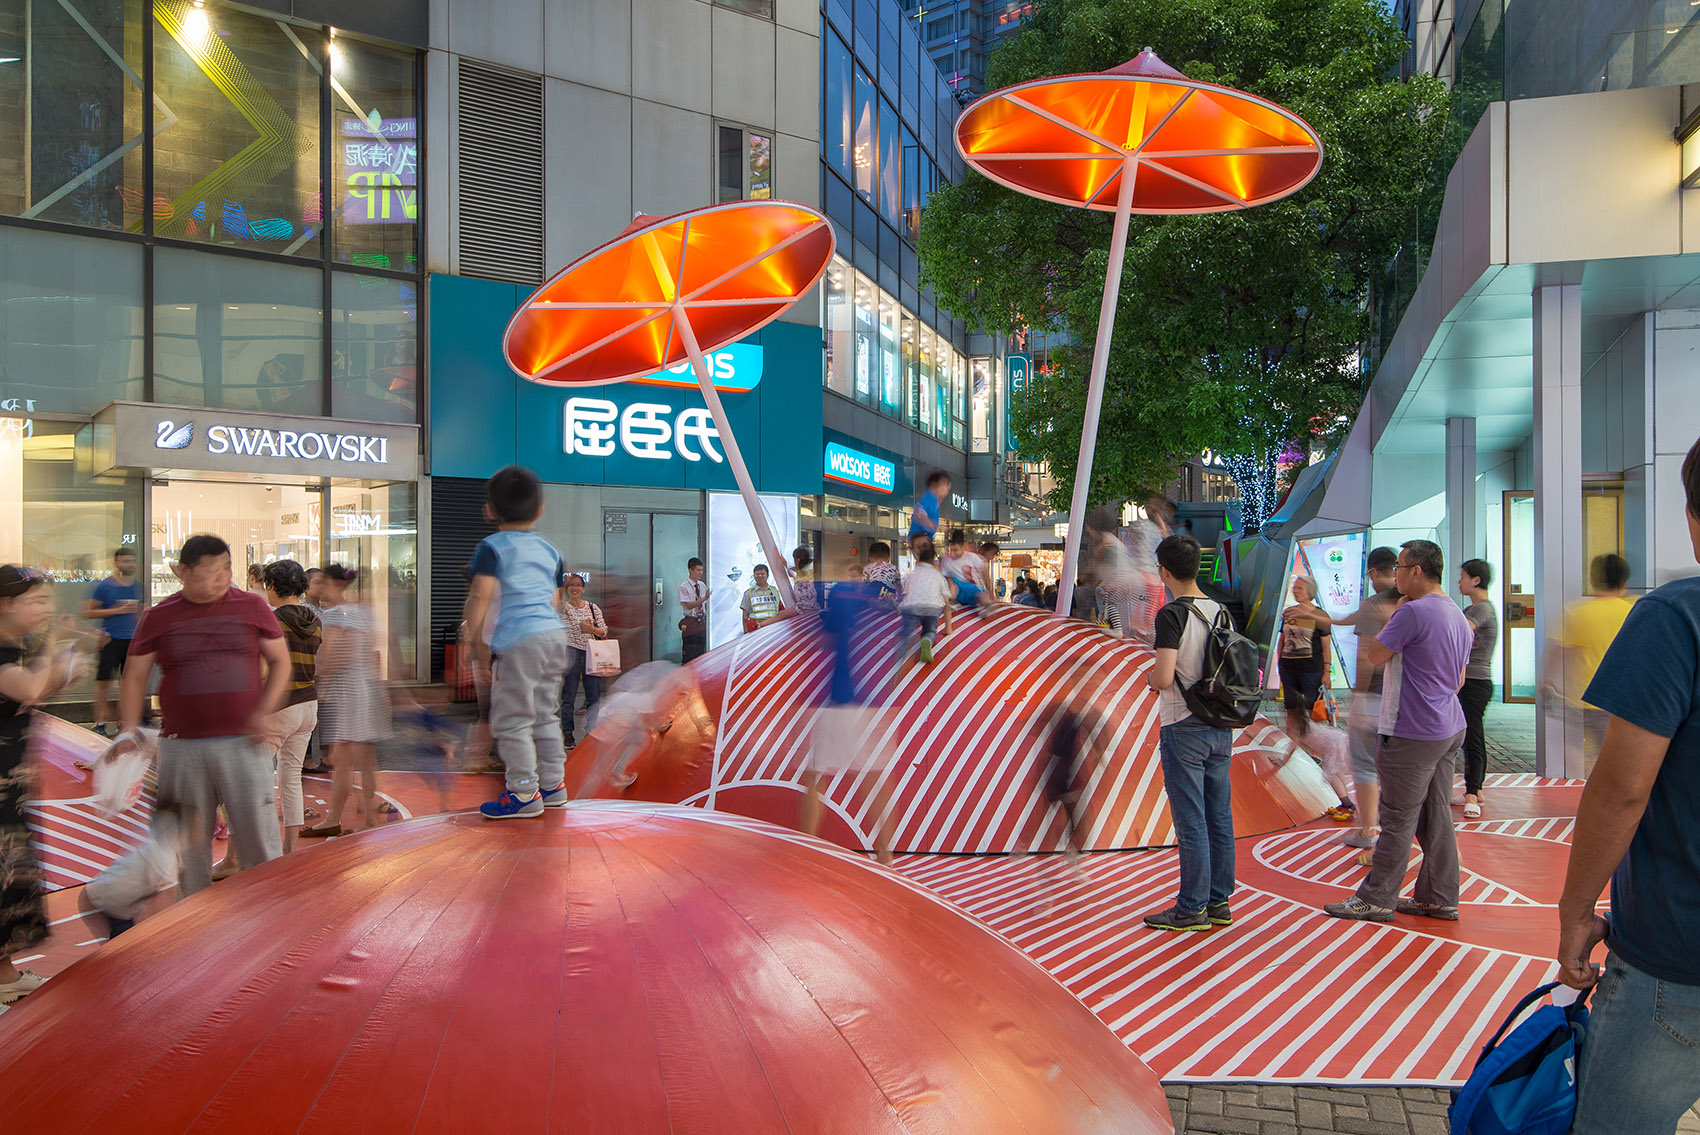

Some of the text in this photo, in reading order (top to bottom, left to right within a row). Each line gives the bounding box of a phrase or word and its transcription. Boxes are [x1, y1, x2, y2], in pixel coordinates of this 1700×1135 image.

[207, 425, 388, 464] SWAROVSKI
[563, 396, 724, 464] 屈臣氏
[830, 449, 870, 480] watsons
